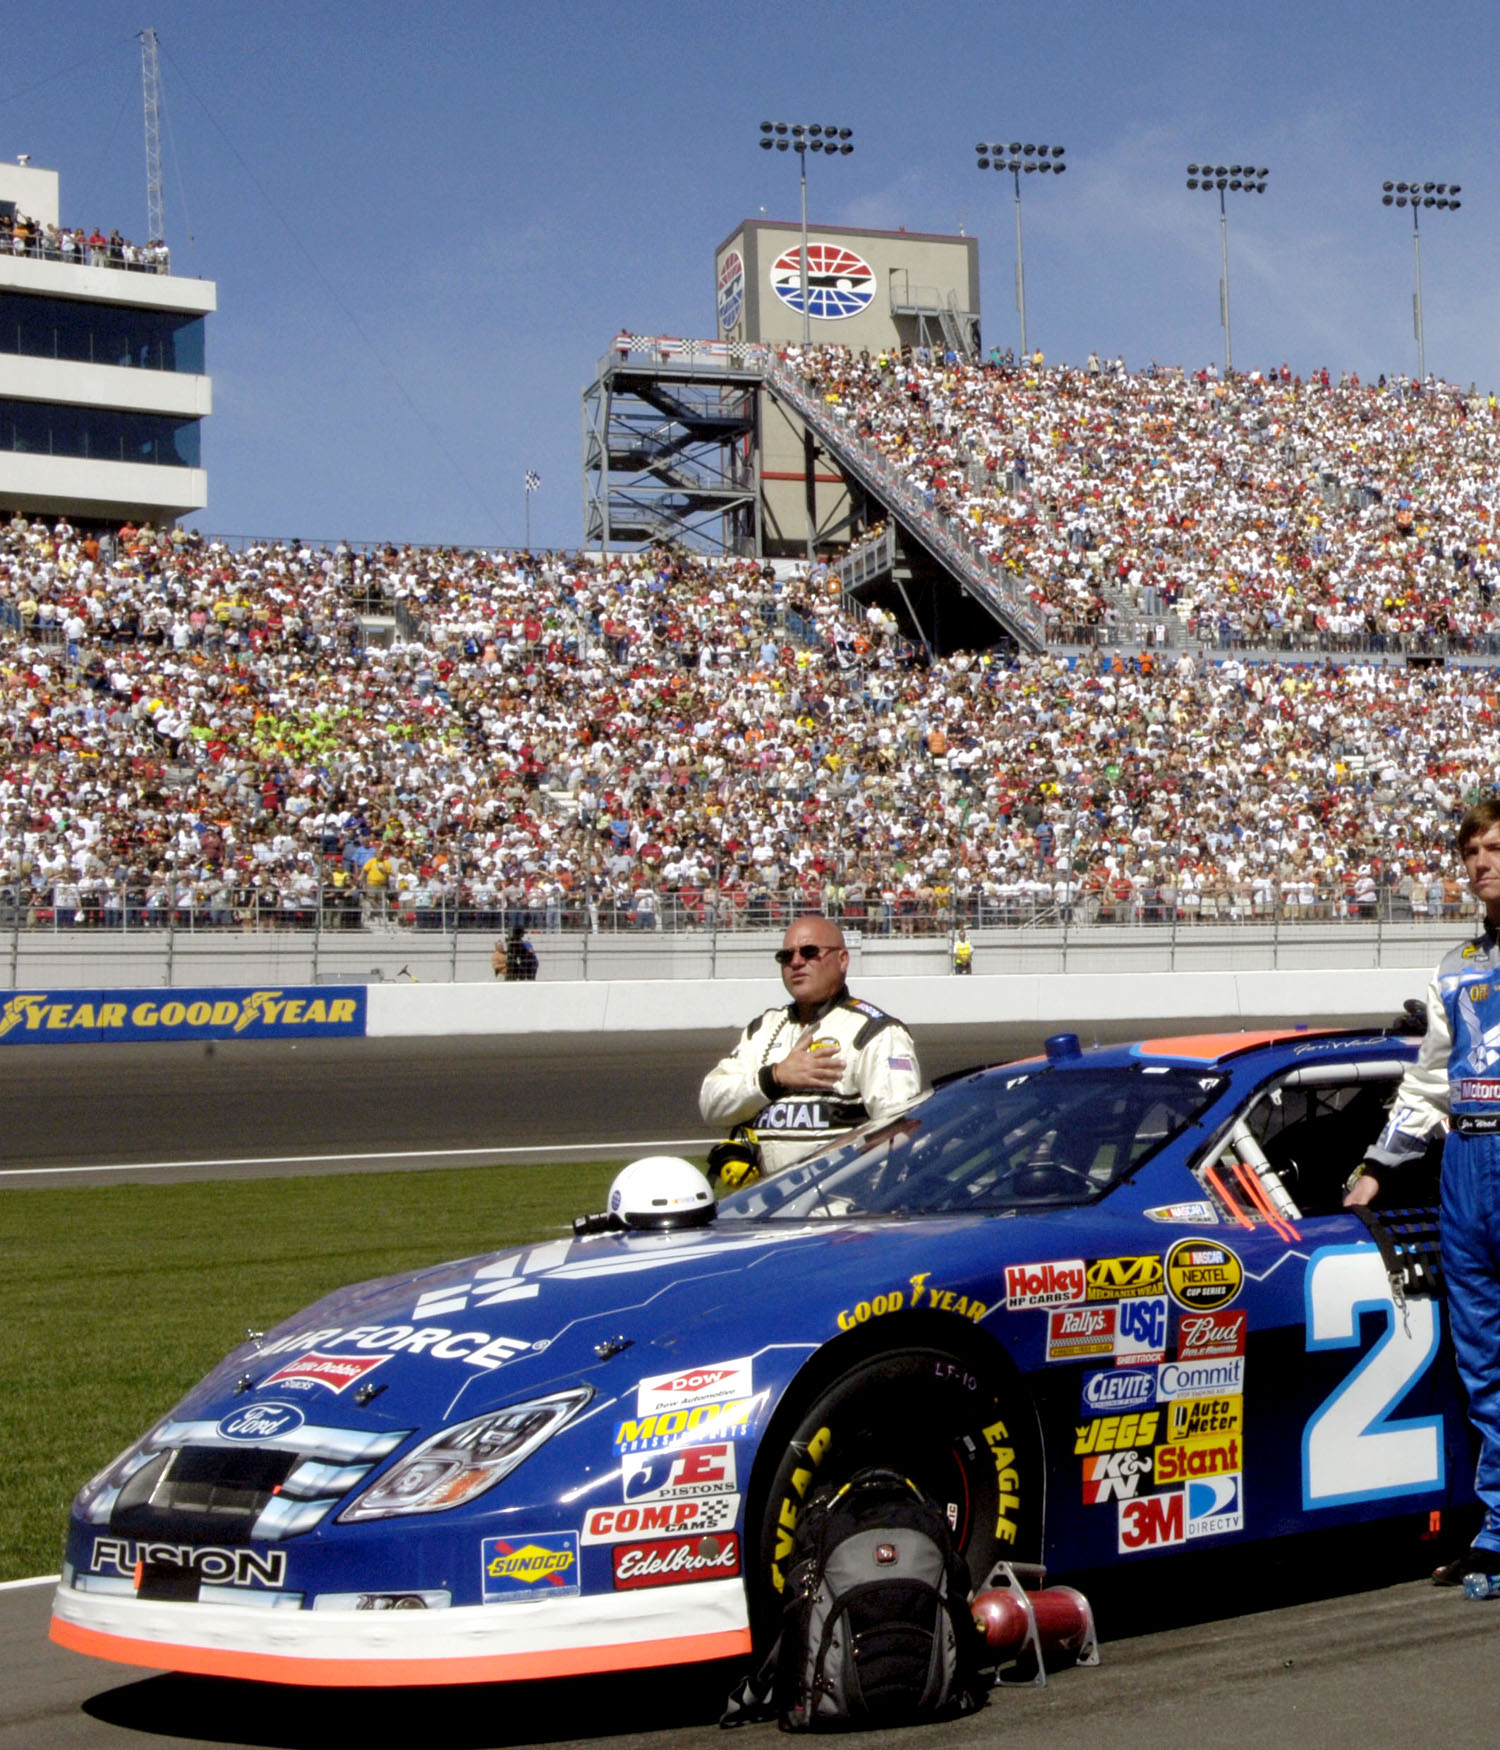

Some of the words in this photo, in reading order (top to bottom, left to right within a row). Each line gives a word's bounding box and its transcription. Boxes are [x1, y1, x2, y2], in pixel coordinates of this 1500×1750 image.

[1191, 1251, 1225, 1265] NASCAR
[1007, 1264, 1084, 1300] Holley
[1182, 1266, 1229, 1283] NEXTEL
[1009, 1297, 1025, 1307] HP
[1028, 1292, 1071, 1306] CARBS
[1186, 1286, 1201, 1297] CUP
[1202, 1285, 1227, 1296] SERIES
[1120, 1299, 1164, 1348] USG
[1181, 1316, 1244, 1347] Bud
[1087, 1373, 1152, 1402] CLEVITE
[1159, 1359, 1241, 1396] Commit
[226, 1406, 291, 1435] Ford
[1187, 1413, 1237, 1432] Meter
[1190, 1401, 1230, 1418] Auto
[1074, 1411, 1161, 1455] JEGS
[626, 1444, 728, 1499] JE
[1158, 1438, 1239, 1481] Stant
[658, 1481, 735, 1498] PISTONS
[982, 1420, 1020, 1545] EAGLE
[589, 1502, 700, 1536] COMP
[664, 1519, 719, 1533] CAMS
[1121, 1494, 1184, 1548] 3M
[1188, 1516, 1240, 1535] DIRECTV
[90, 1536, 287, 1588] FUSION
[492, 1553, 571, 1574] SUNOCO
